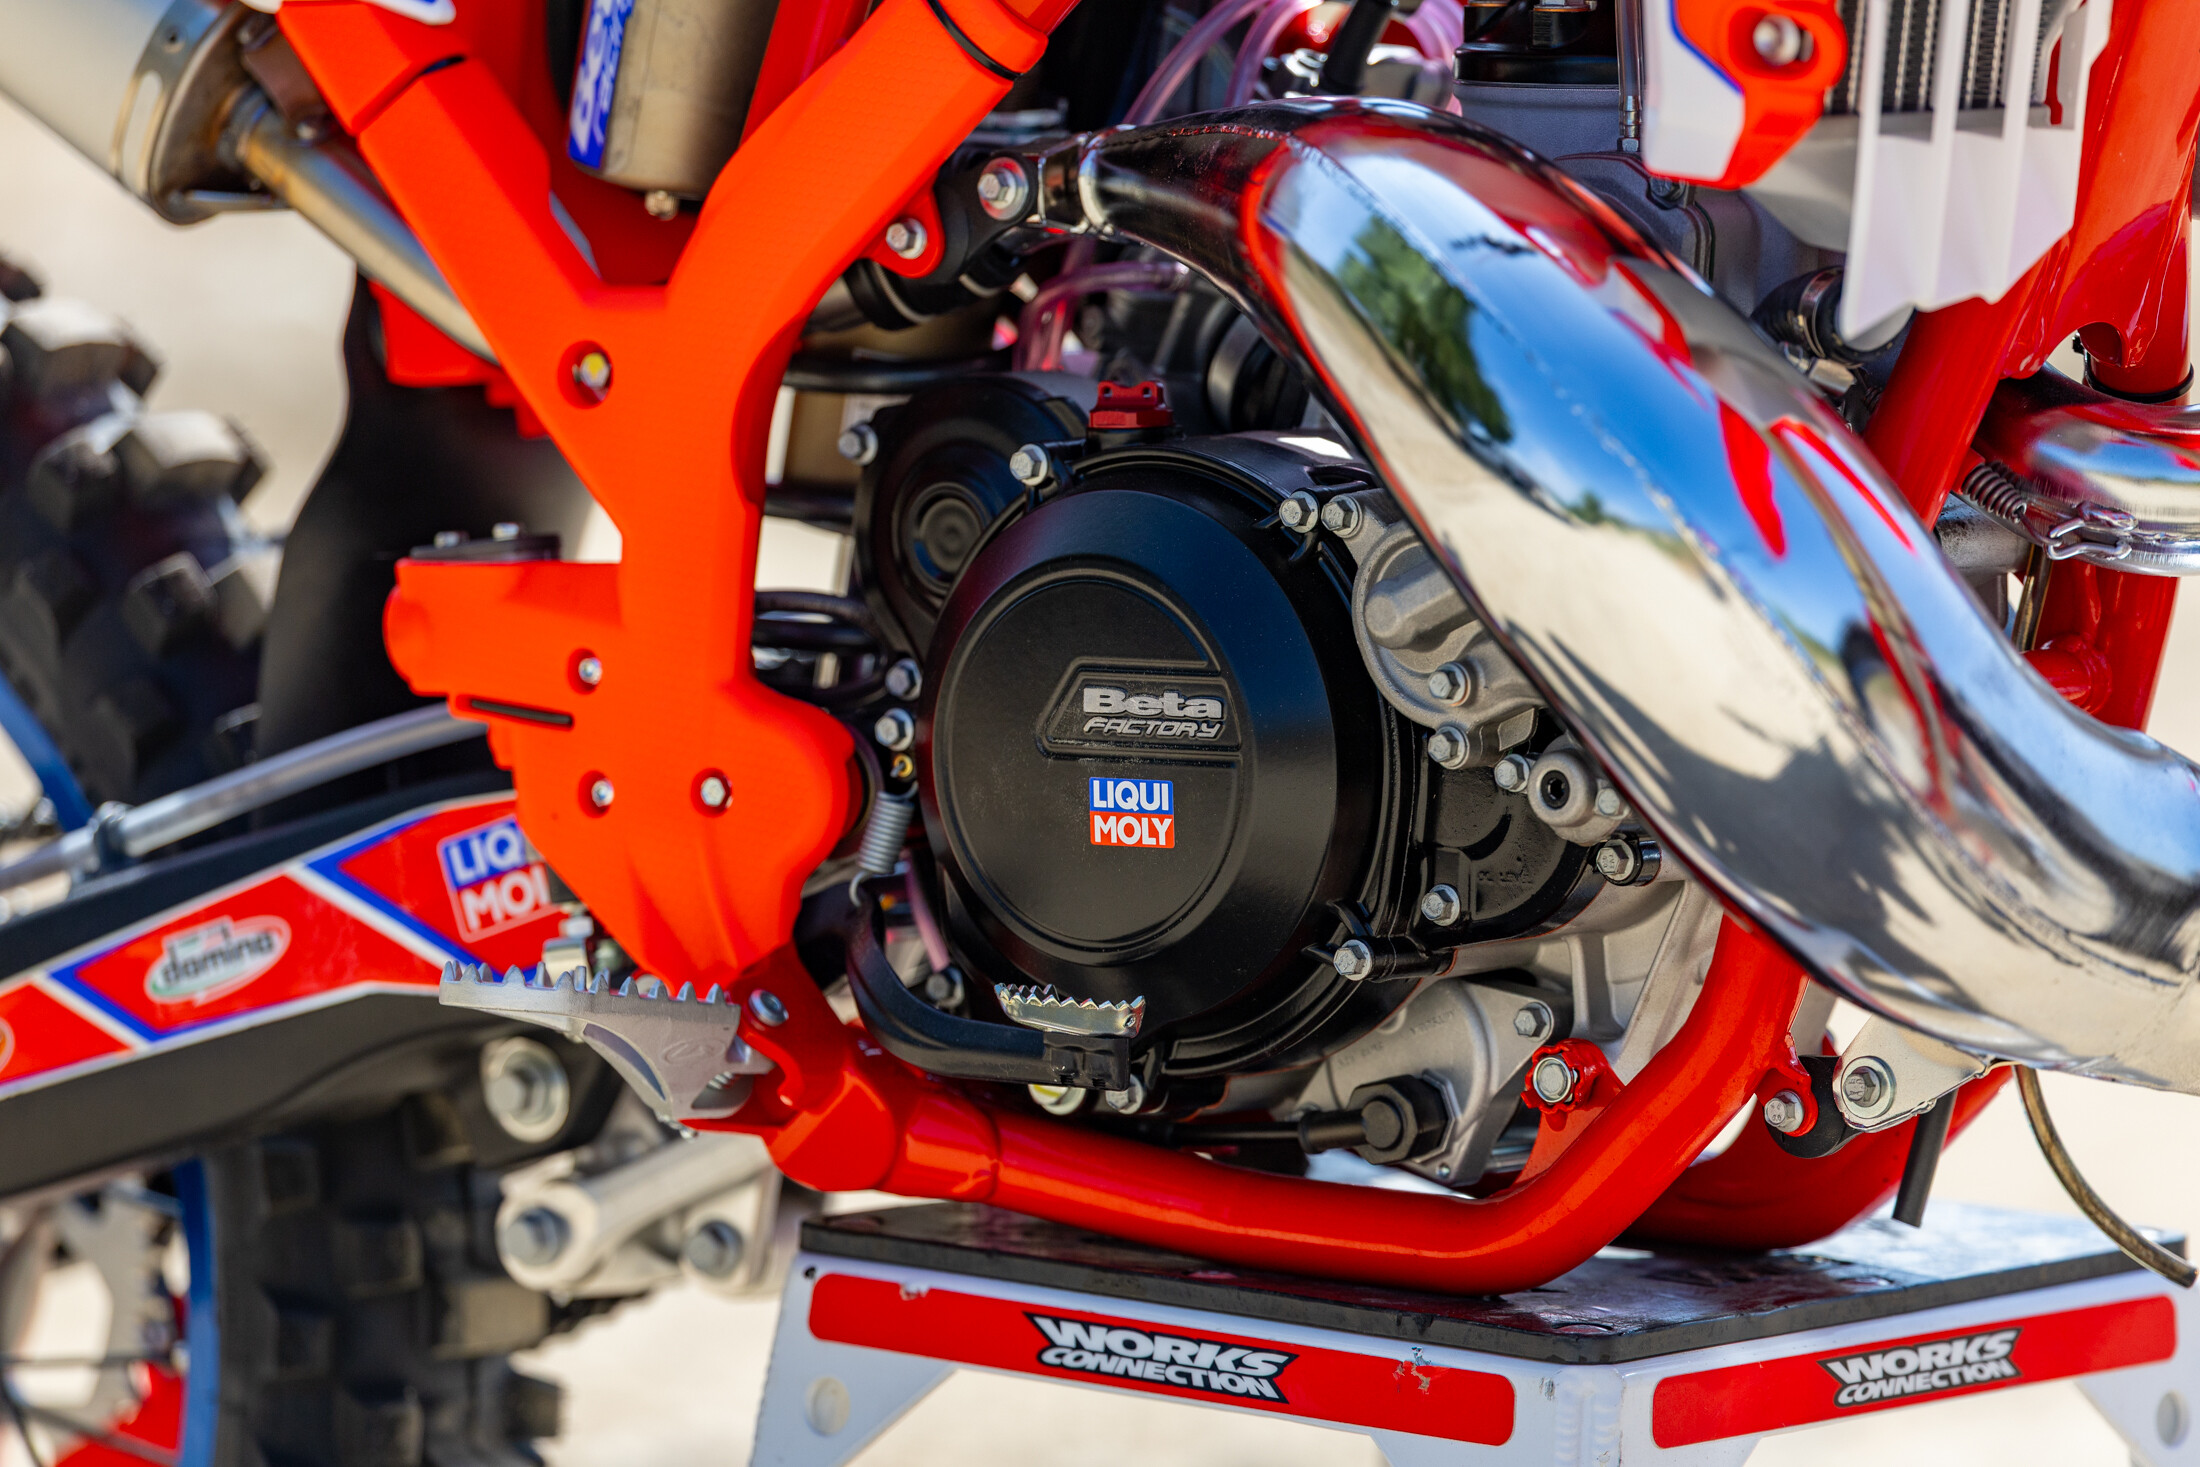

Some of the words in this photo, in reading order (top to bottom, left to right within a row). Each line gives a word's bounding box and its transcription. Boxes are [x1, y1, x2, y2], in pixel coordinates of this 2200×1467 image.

[1083, 687, 1223, 719] Beta
[1083, 716, 1222, 738] FACTORY
[1093, 780, 1169, 812] LIQUI
[449, 826, 524, 883] LIQ
[1094, 815, 1172, 846] MOLY
[161, 926, 274, 985] domino
[1033, 1316, 1289, 1377] WORKS
[1827, 1330, 2018, 1384] WORKS
[1040, 1347, 1279, 1399] CONNECTION
[1838, 1358, 2017, 1404] CONNECTION
